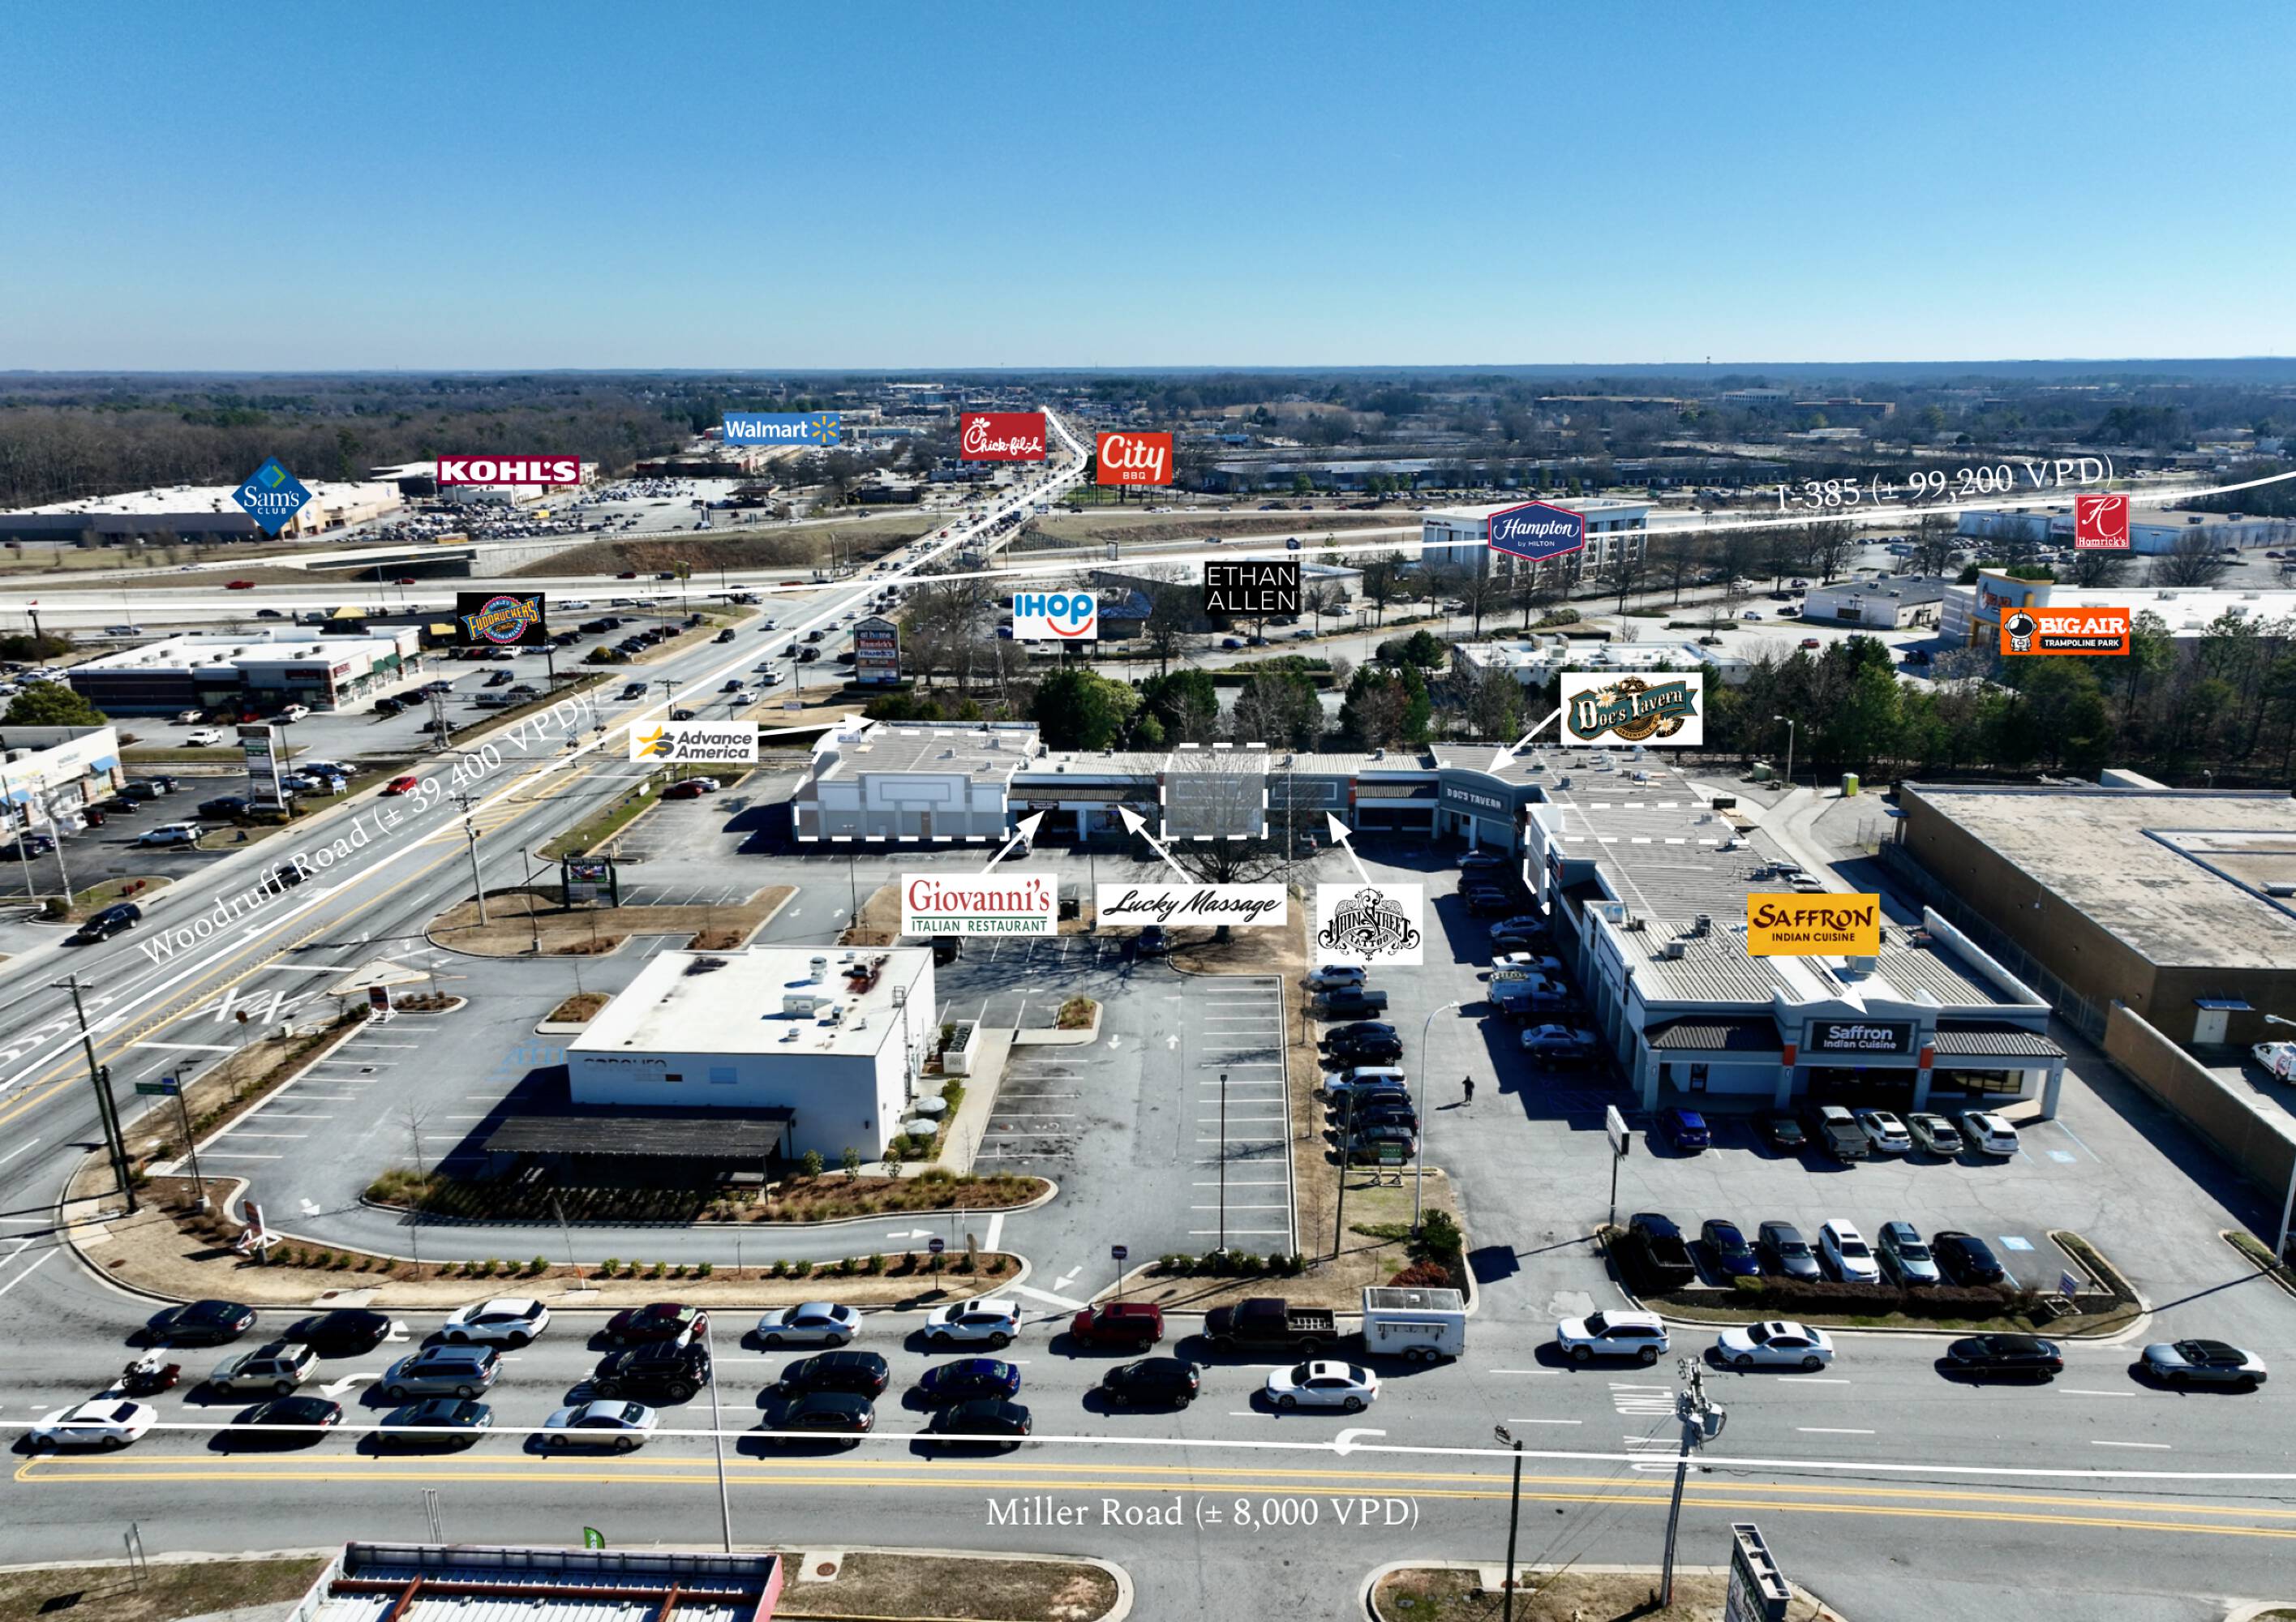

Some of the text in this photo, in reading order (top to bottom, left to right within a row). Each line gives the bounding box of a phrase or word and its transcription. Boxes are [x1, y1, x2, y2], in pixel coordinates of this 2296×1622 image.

[1447, 788, 1502, 809] DOC'S TAVERN
[1829, 1025, 1894, 1040] Saffron
[1823, 1039, 1897, 1049] Indian Cuisine
